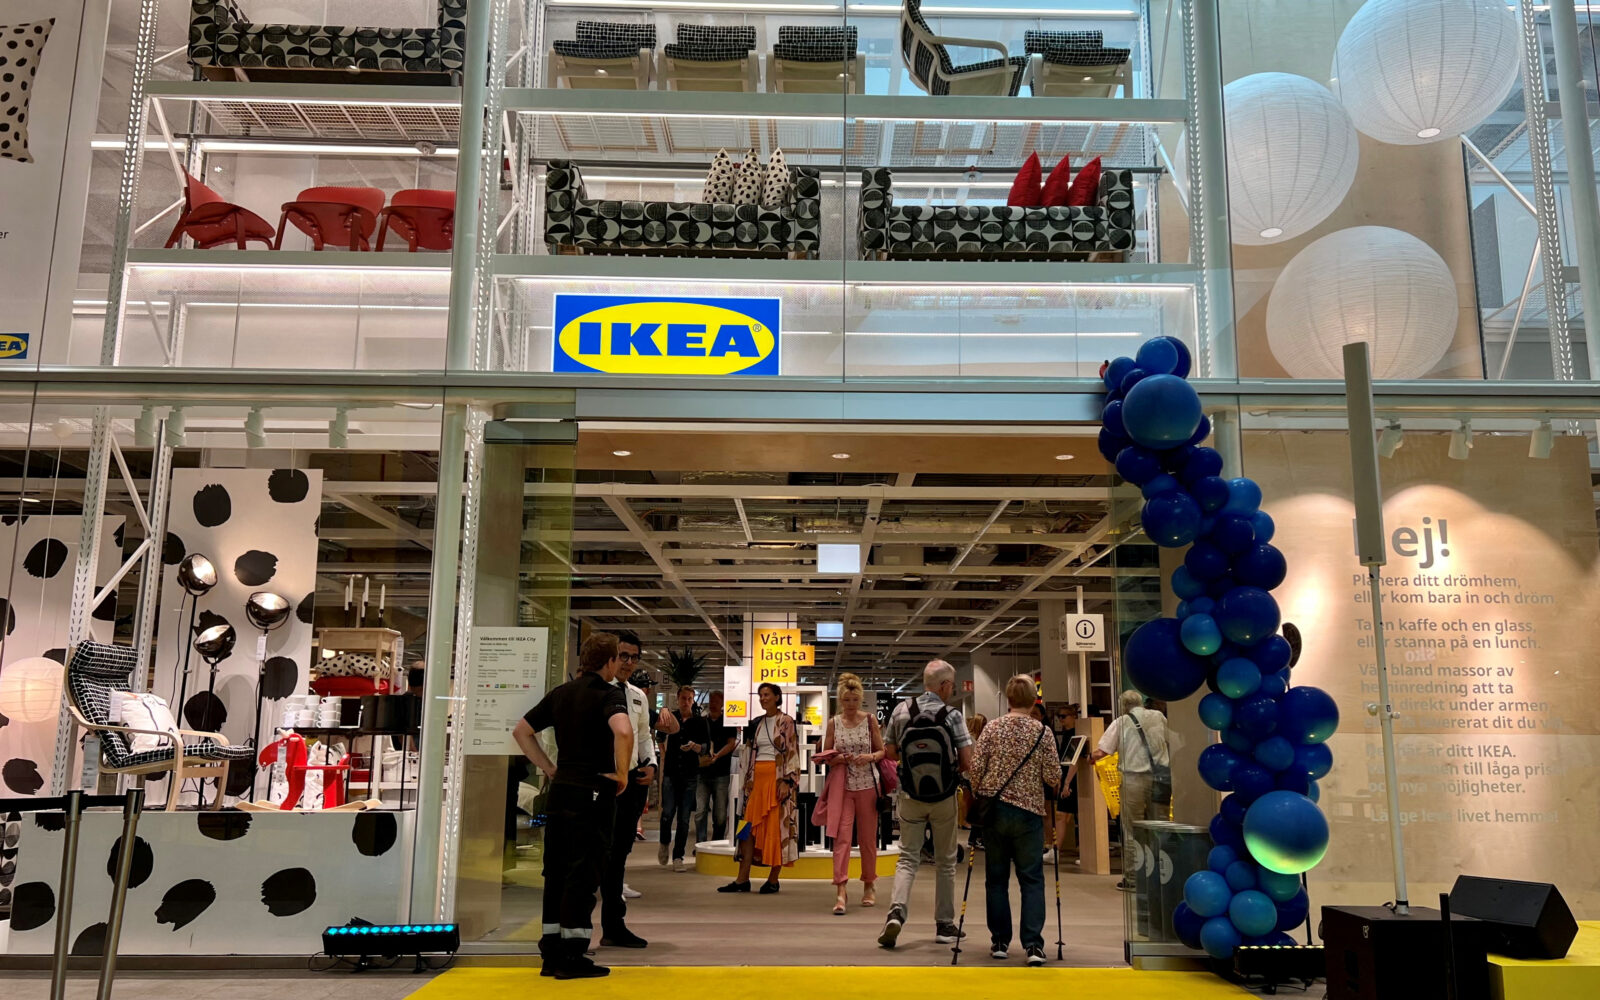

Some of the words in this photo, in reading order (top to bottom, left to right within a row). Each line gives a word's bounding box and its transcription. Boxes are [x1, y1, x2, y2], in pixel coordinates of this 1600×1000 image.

[578, 322, 761, 358] IKEA
[1352, 516, 1451, 569] ej!
[1413, 574, 1440, 586] ditt
[1444, 574, 1521, 588] drömhem,
[1354, 591, 1387, 603] ellr
[1391, 591, 1424, 604] kom
[1428, 591, 1461, 604] bara
[1466, 591, 1480, 604] in
[1484, 591, 1510, 604] och
[1355, 618, 1372, 631] Ta
[1399, 618, 1437, 631] kaffe
[1441, 618, 1468, 631] och
[1472, 621, 1490, 631] en
[1494, 619, 1537, 635] glass,
[760, 632, 793, 646] Vårt
[1356, 635, 1390, 648] ellr
[1394, 637, 1446, 648] stanna
[1450, 635, 1468, 651] på
[1472, 638, 1491, 649] en
[1495, 635, 1542, 649] lunch.
[760, 648, 807, 664] lägsta
[760, 666, 789, 681] pris
[1391, 663, 1433, 676] bland
[1437, 667, 1492, 676] massor
[1496, 667, 1514, 676] av
[1360, 680, 1468, 697] heinredning
[1472, 683, 1494, 694] att
[1498, 683, 1514, 694] ta
[1401, 698, 1445, 711] direkt
[1449, 698, 1494, 711] under
[1493, 716, 1513, 728] dit
[1517, 715, 1536, 728] du
[1447, 744, 1474, 757] ditt
[1478, 745, 1517, 757] IKEA.
[1463, 762, 1483, 775] till
[1487, 761, 1520, 779] låga
[1457, 808, 1491, 822] livet
